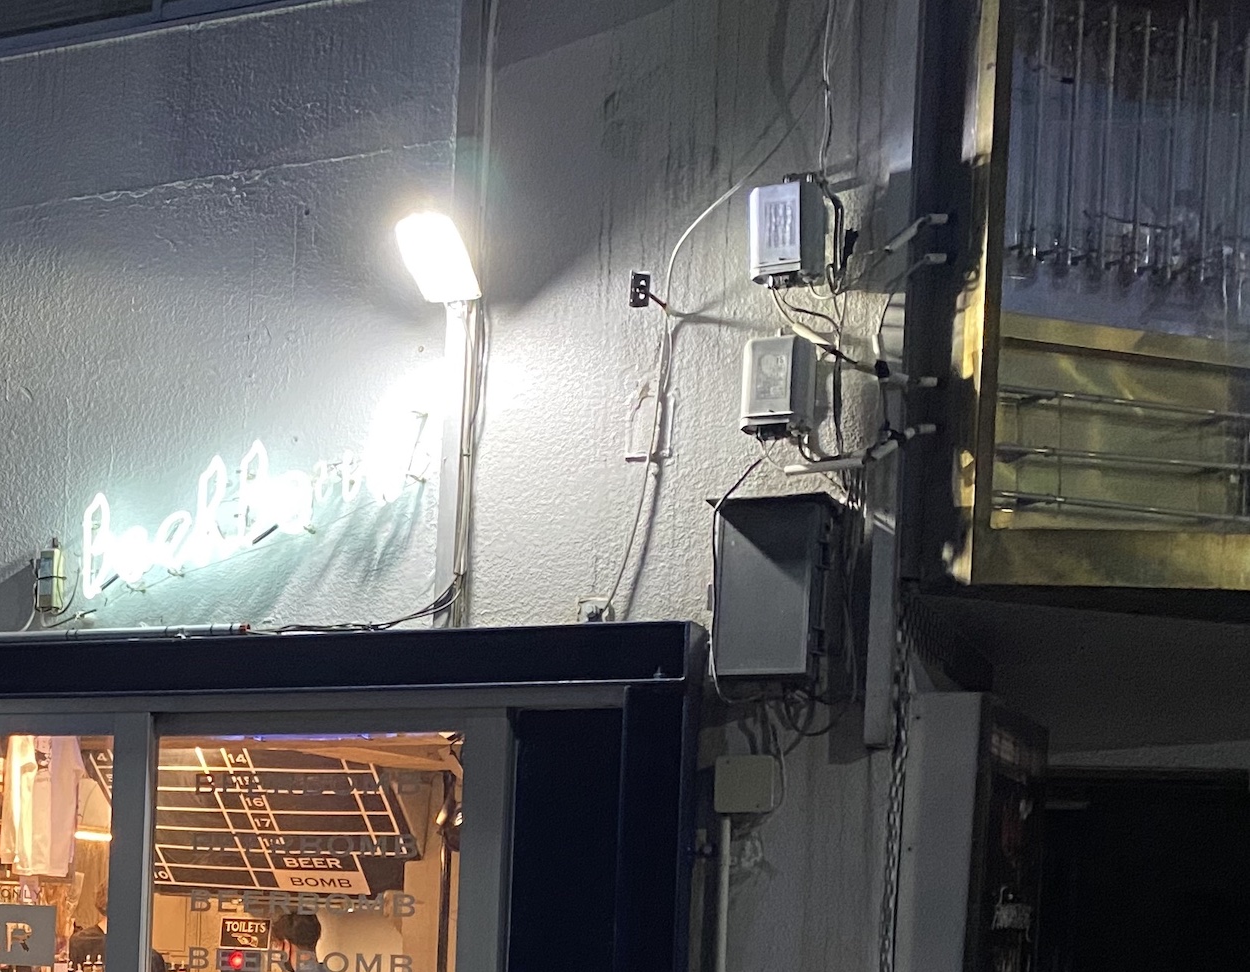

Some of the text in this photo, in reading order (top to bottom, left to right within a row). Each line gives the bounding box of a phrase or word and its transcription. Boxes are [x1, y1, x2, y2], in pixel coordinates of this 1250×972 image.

[227, 754, 248, 764] 14
[246, 797, 265, 807] 16
[254, 818, 271, 828] 17
[283, 857, 343, 869] BEER
[290, 877, 352, 888] BOMB
[1, 889, 42, 899] ONLY
[190, 888, 415, 917] BEERBOMB
[225, 921, 267, 933] TOILETS
